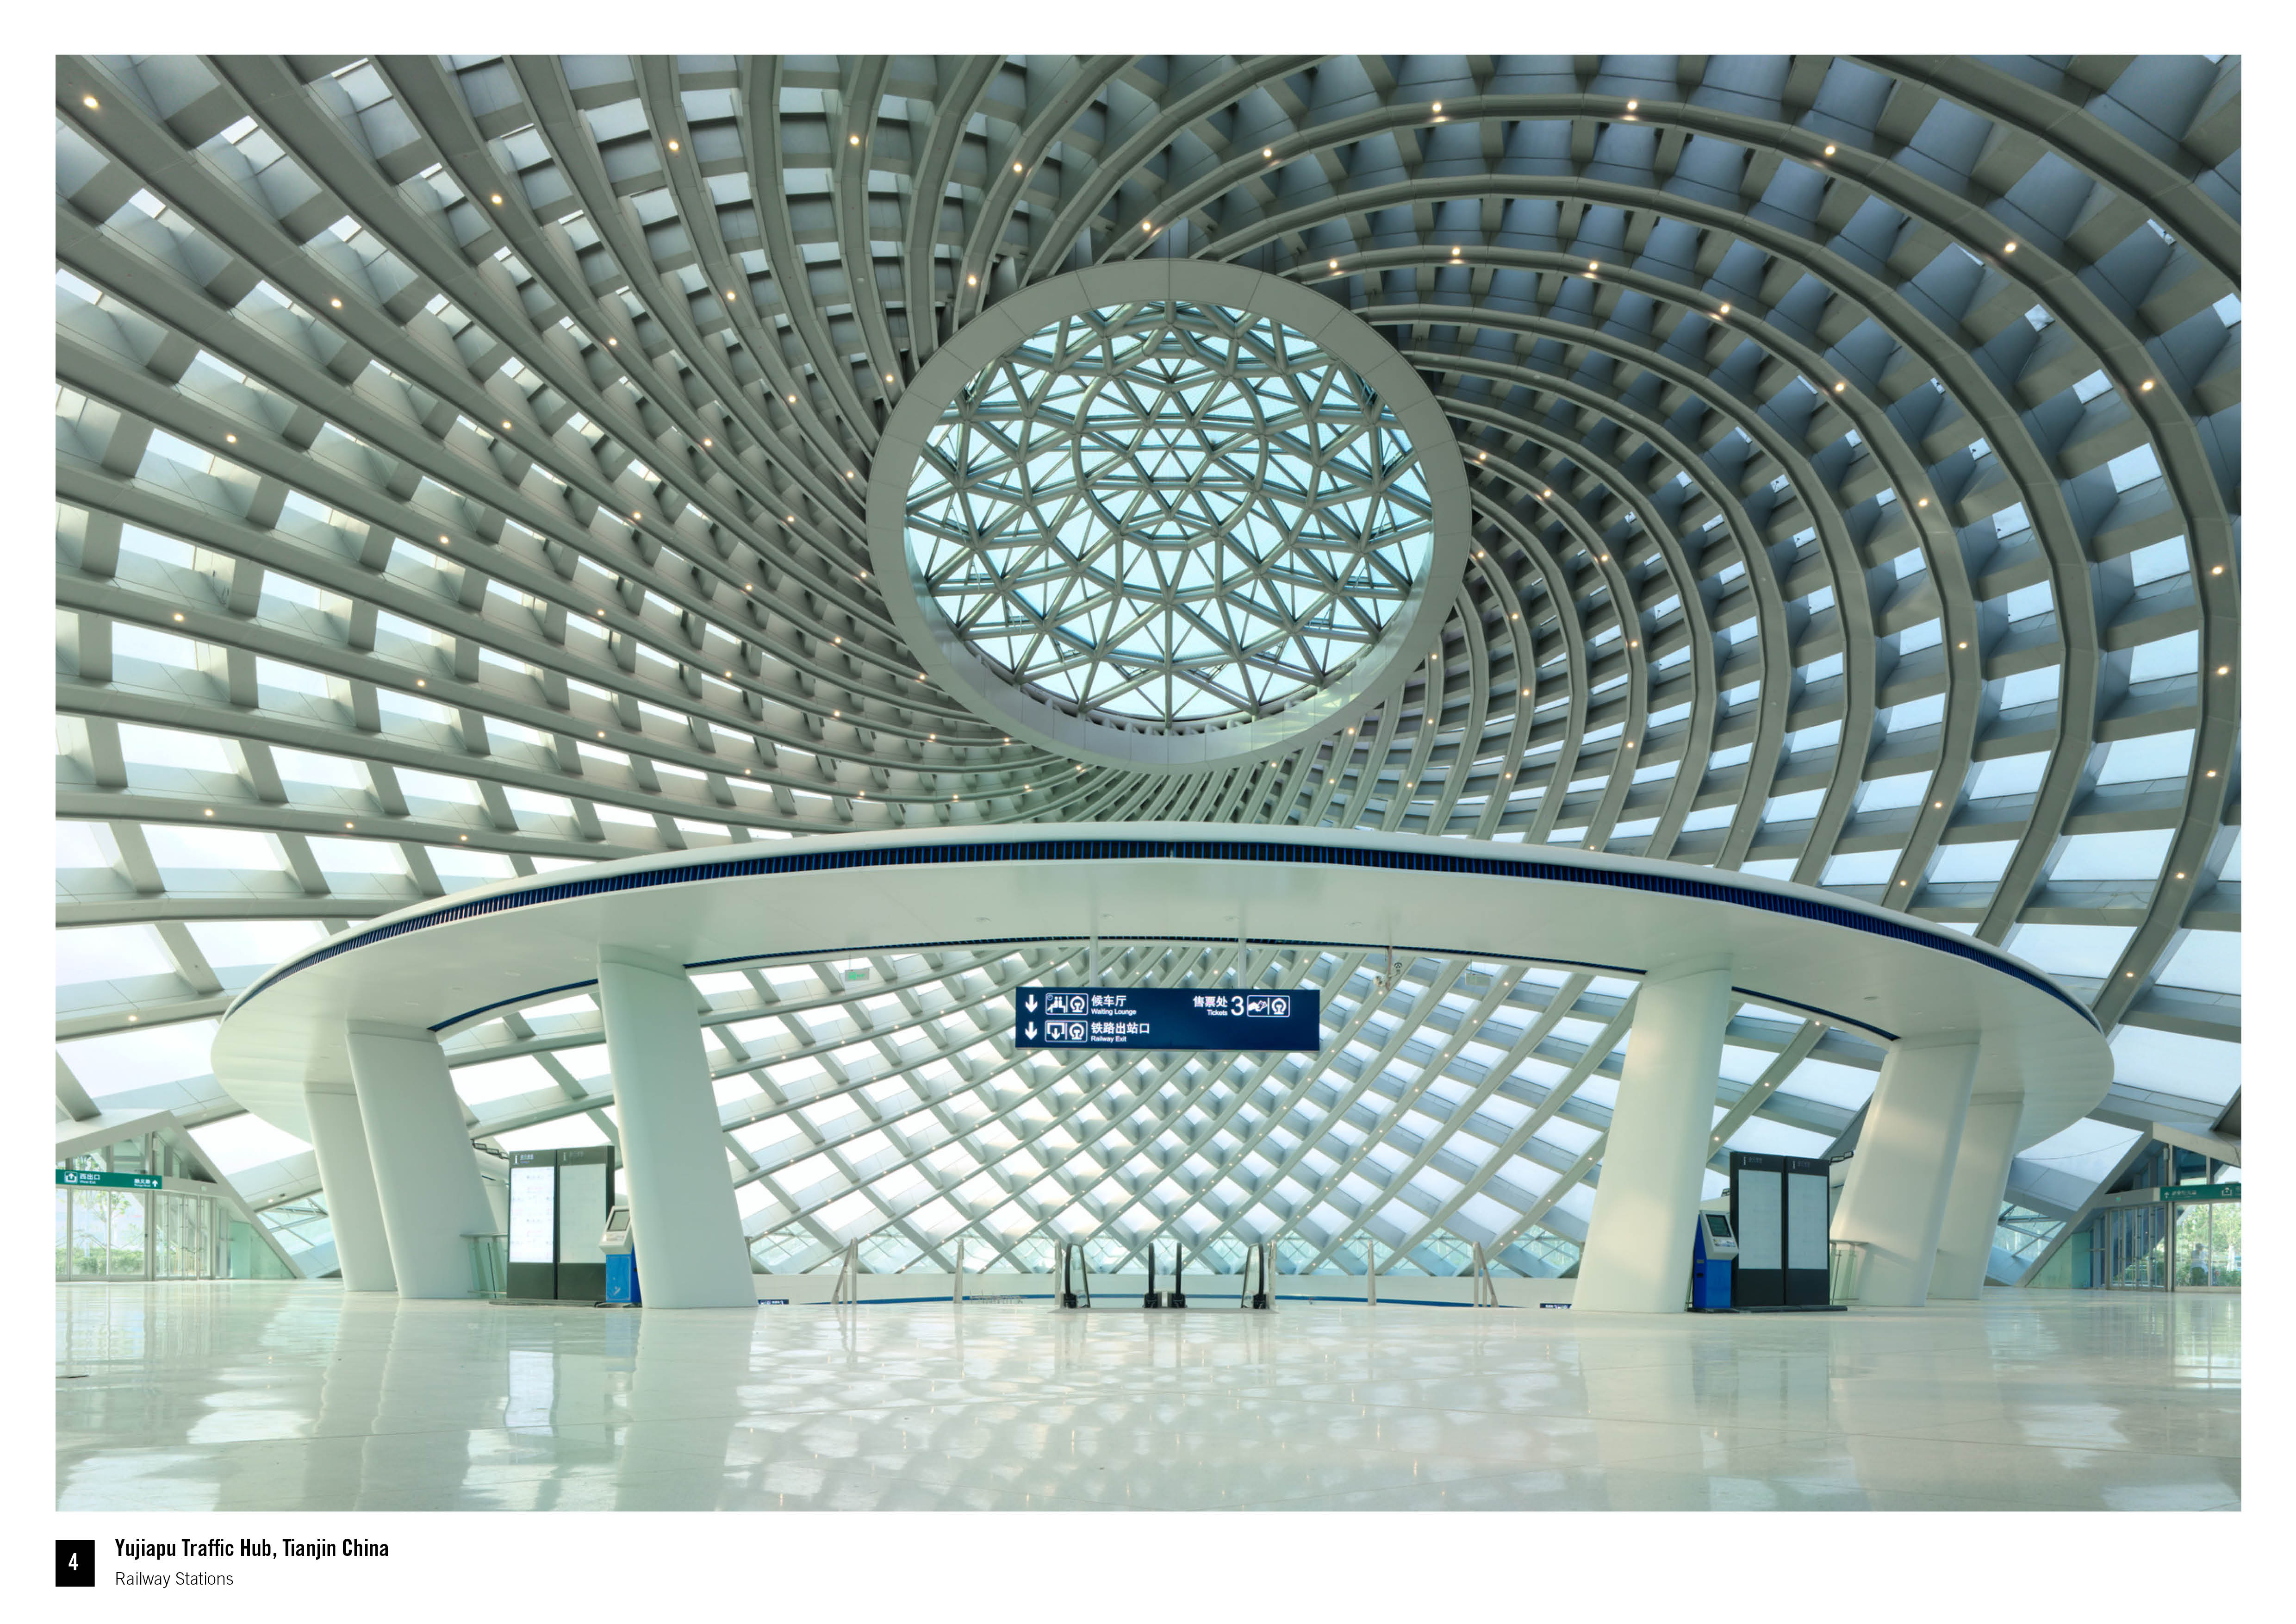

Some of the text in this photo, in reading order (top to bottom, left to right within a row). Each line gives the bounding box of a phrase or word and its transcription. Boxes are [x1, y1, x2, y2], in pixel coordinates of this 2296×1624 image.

[1091, 995, 1126, 1006] 候车厅
[1193, 996, 1228, 1007] 售票处
[1231, 996, 1244, 1016] 3
[1091, 1022, 1150, 1034] 铁路出站口
